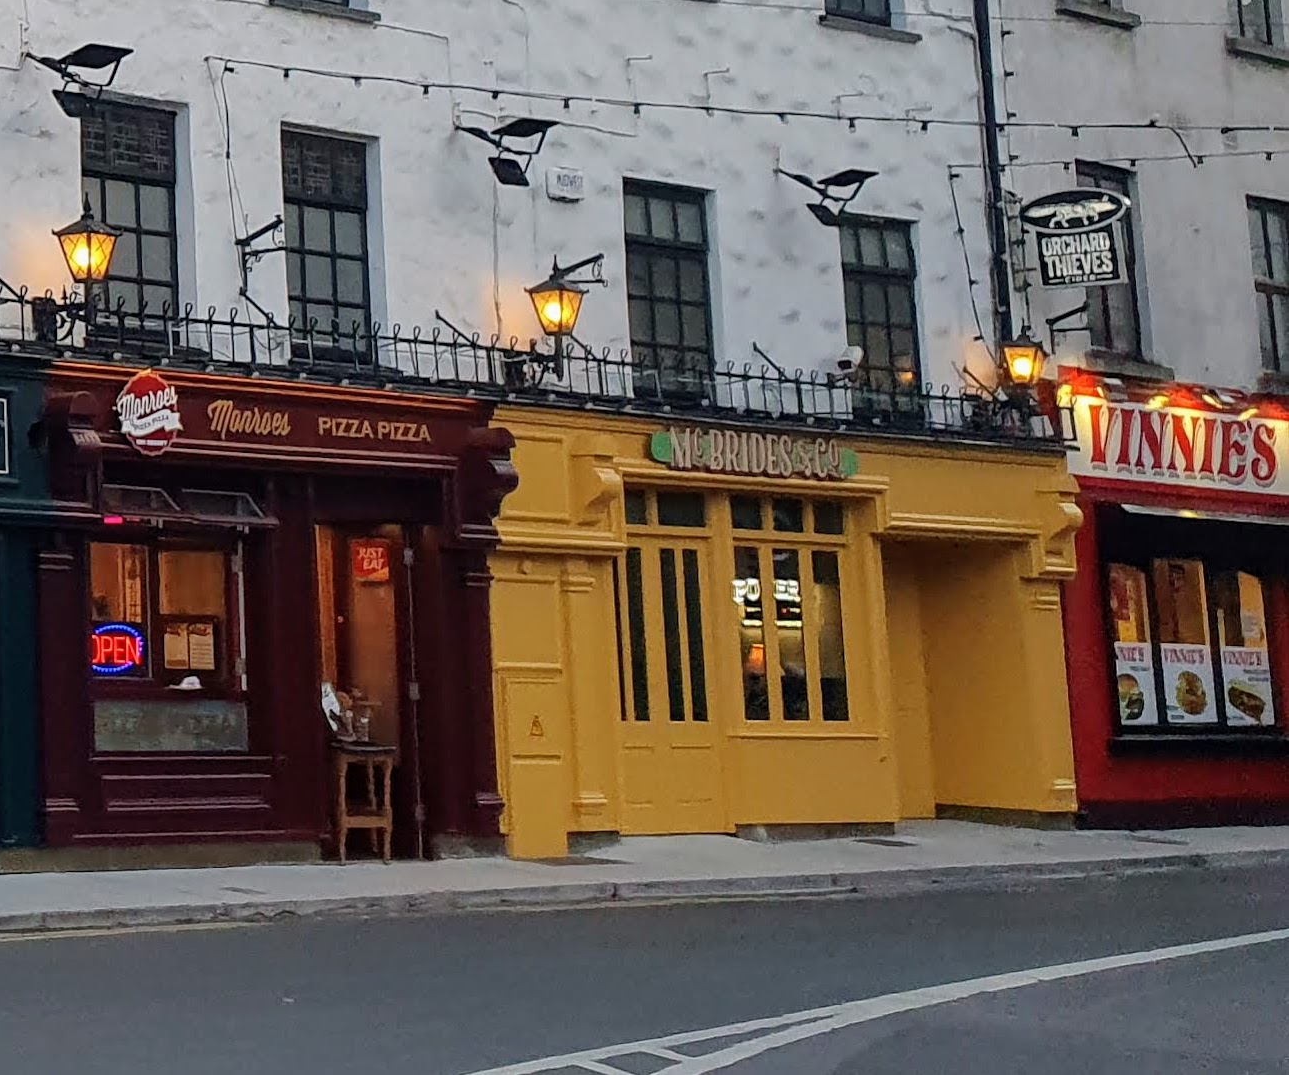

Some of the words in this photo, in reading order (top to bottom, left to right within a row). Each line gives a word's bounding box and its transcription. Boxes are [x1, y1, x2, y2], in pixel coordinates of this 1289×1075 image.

[1042, 231, 1111, 256] ORCHARD
[1044, 251, 1114, 278] THIEVES
[117, 386, 178, 421] Monroes
[207, 399, 291, 440] Monroes
[318, 416, 374, 439] PIZZA
[377, 421, 432, 442] PIZZA
[1088, 404, 1279, 488] VINNIE'S
[357, 547, 384, 559] JUST
[363, 558, 384, 570] EAT
